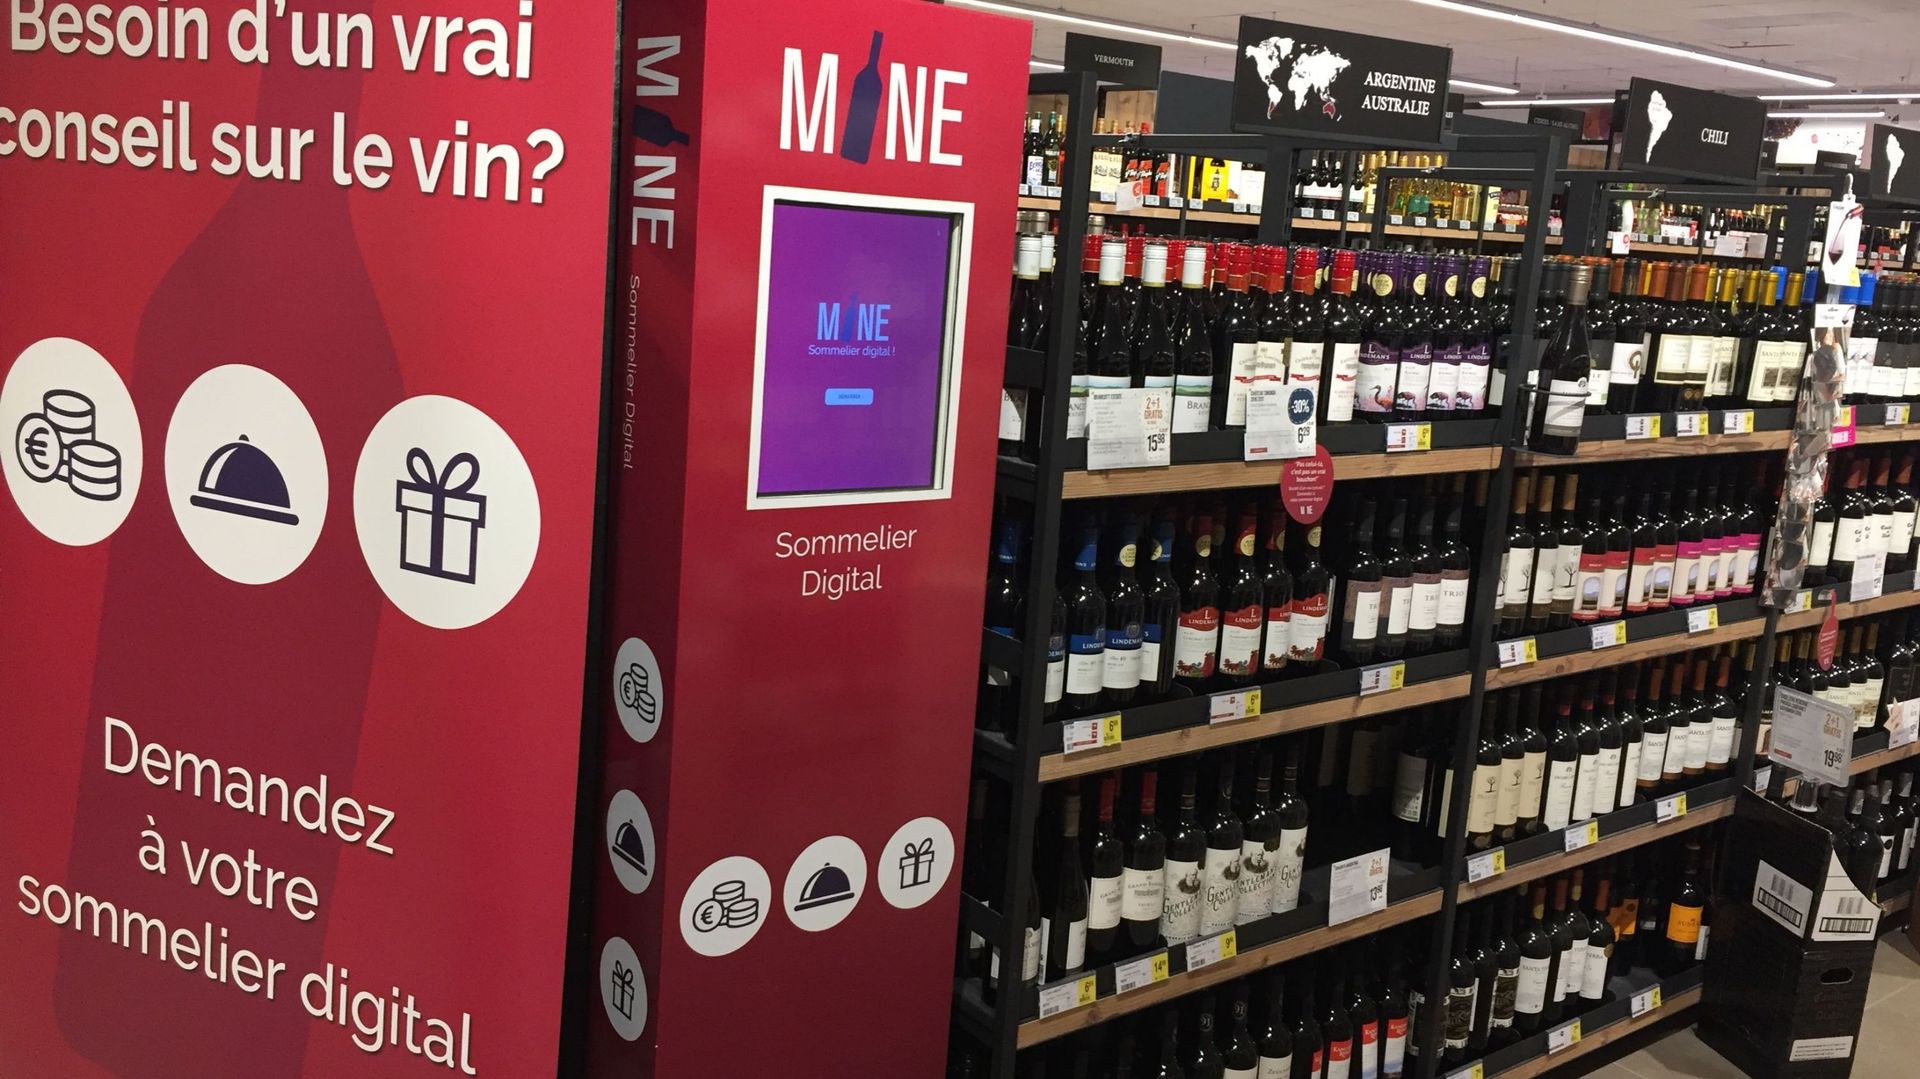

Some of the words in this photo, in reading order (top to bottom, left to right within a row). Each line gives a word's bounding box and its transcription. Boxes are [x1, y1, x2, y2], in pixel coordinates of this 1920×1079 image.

[11, 0, 208, 59] Besoin
[392, 0, 533, 80] vrai
[1094, 54, 1134, 67] VERMOUTH
[1364, 71, 1436, 94] ARGENTINE
[1361, 94, 1430, 116] AUSTRALIE
[0, 100, 198, 173] conseil
[211, 118, 315, 182] sur
[332, 111, 394, 190] le
[410, 120, 565, 204] vin?
[1701, 127, 1729, 145] CHILI
[626, 274, 640, 397] Sommelier
[808, 344, 860, 356] Sommelier
[862, 345, 890, 358] digital
[1187, 401, 1209, 409] BRAN
[1291, 400, 1310, 414] -30%
[623, 402, 635, 469] Digital
[776, 524, 918, 558] Sommelier
[802, 564, 882, 600] Digital
[104, 716, 396, 855] Demandez
[138, 815, 167, 875] à
[181, 840, 319, 921] votre
[17, 875, 287, 1000] sommelier
[301, 962, 476, 1075] digital
